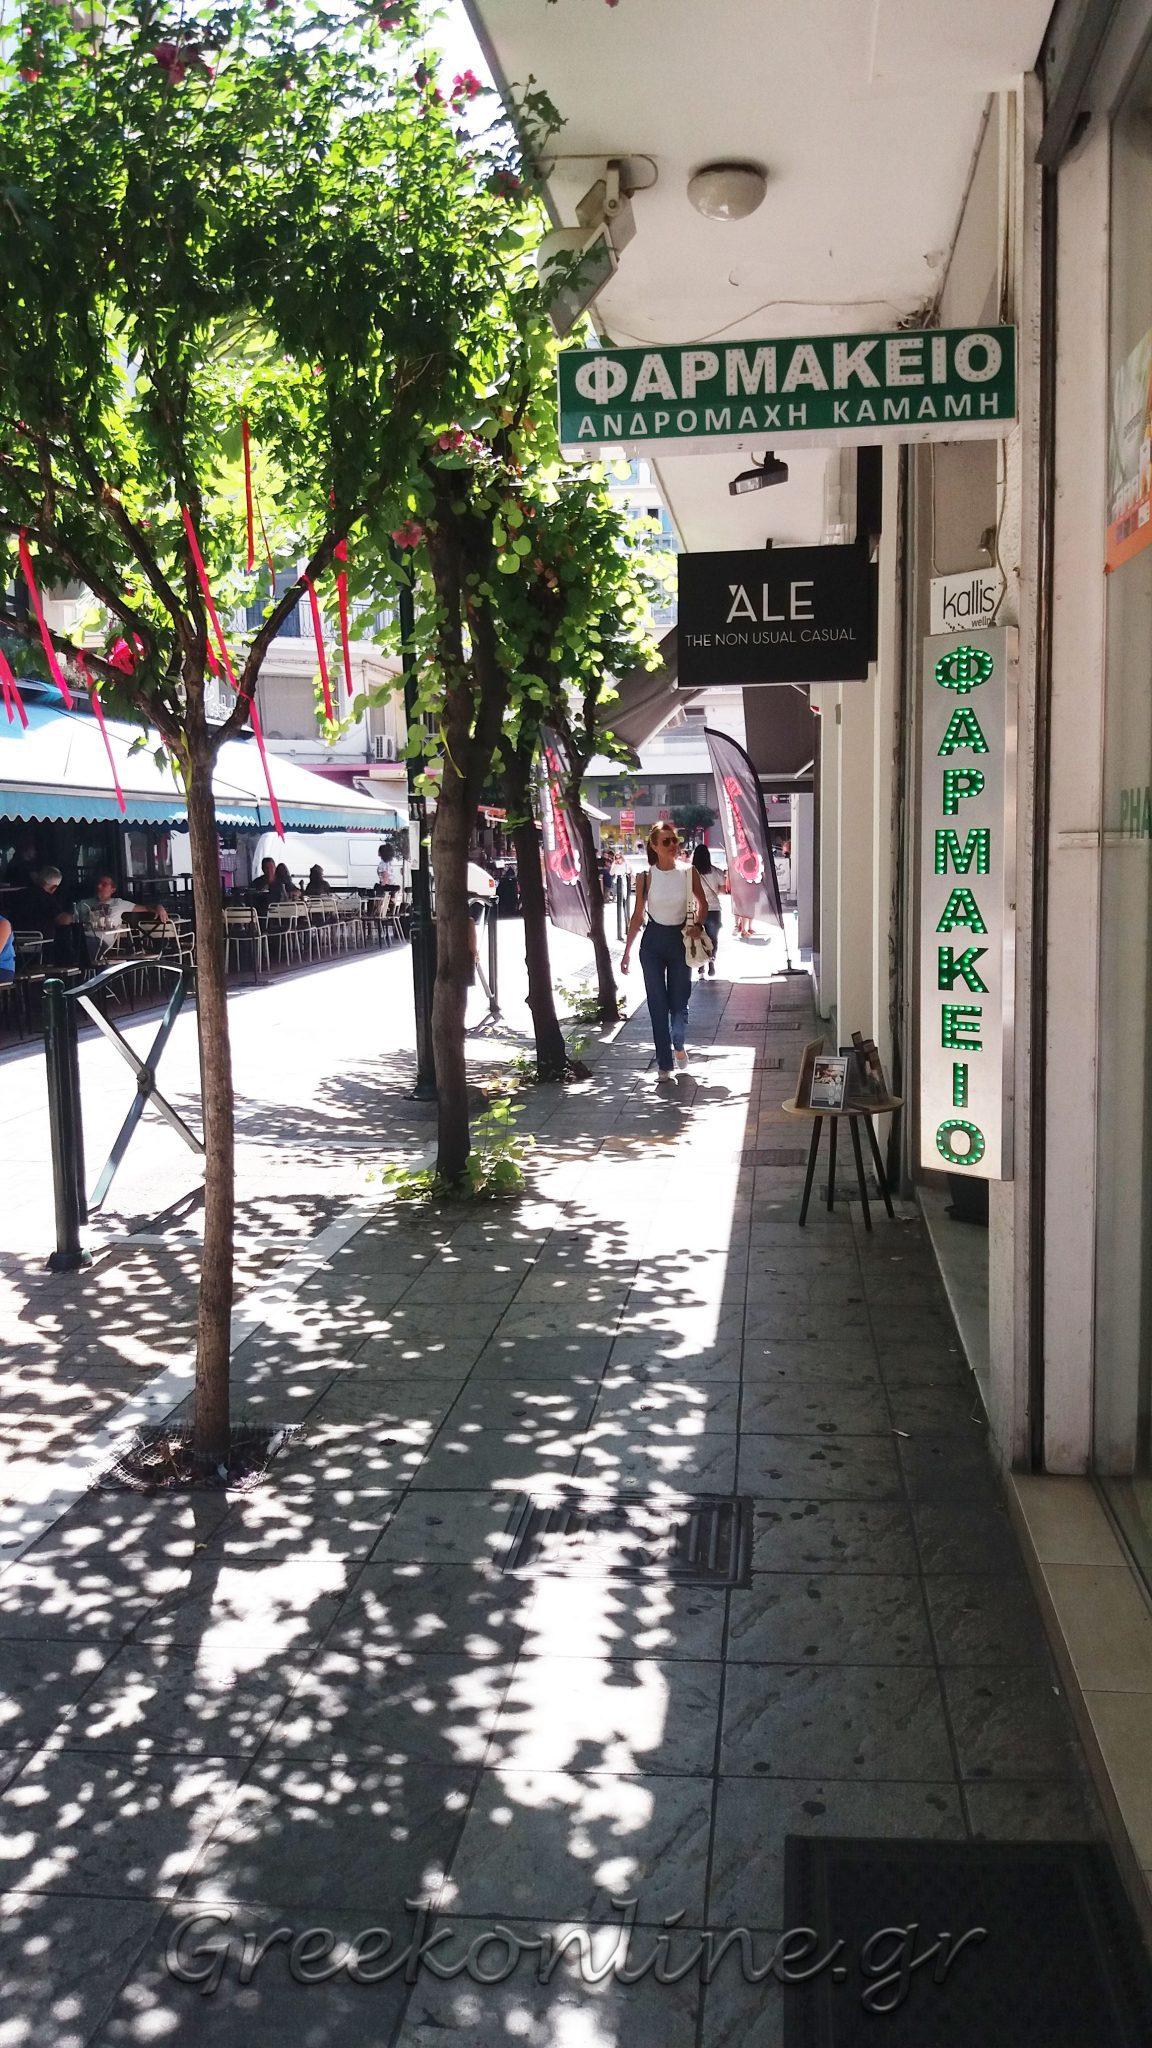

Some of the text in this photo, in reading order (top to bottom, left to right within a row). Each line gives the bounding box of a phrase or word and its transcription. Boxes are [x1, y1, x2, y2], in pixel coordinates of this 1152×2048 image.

[575, 333, 1003, 405] ΦΑΡΜΑΚΕΙΟ
[577, 392, 999, 439] ΑΝΔΡΟΜΑΧΗ ΚΑΜΑΜΗ
[943, 579, 995, 619] kallis
[685, 627, 857, 648] THE NON USUAL CASUAL
[934, 645, 994, 1165] ΦΑΡΜΑΚΕΙΟ
